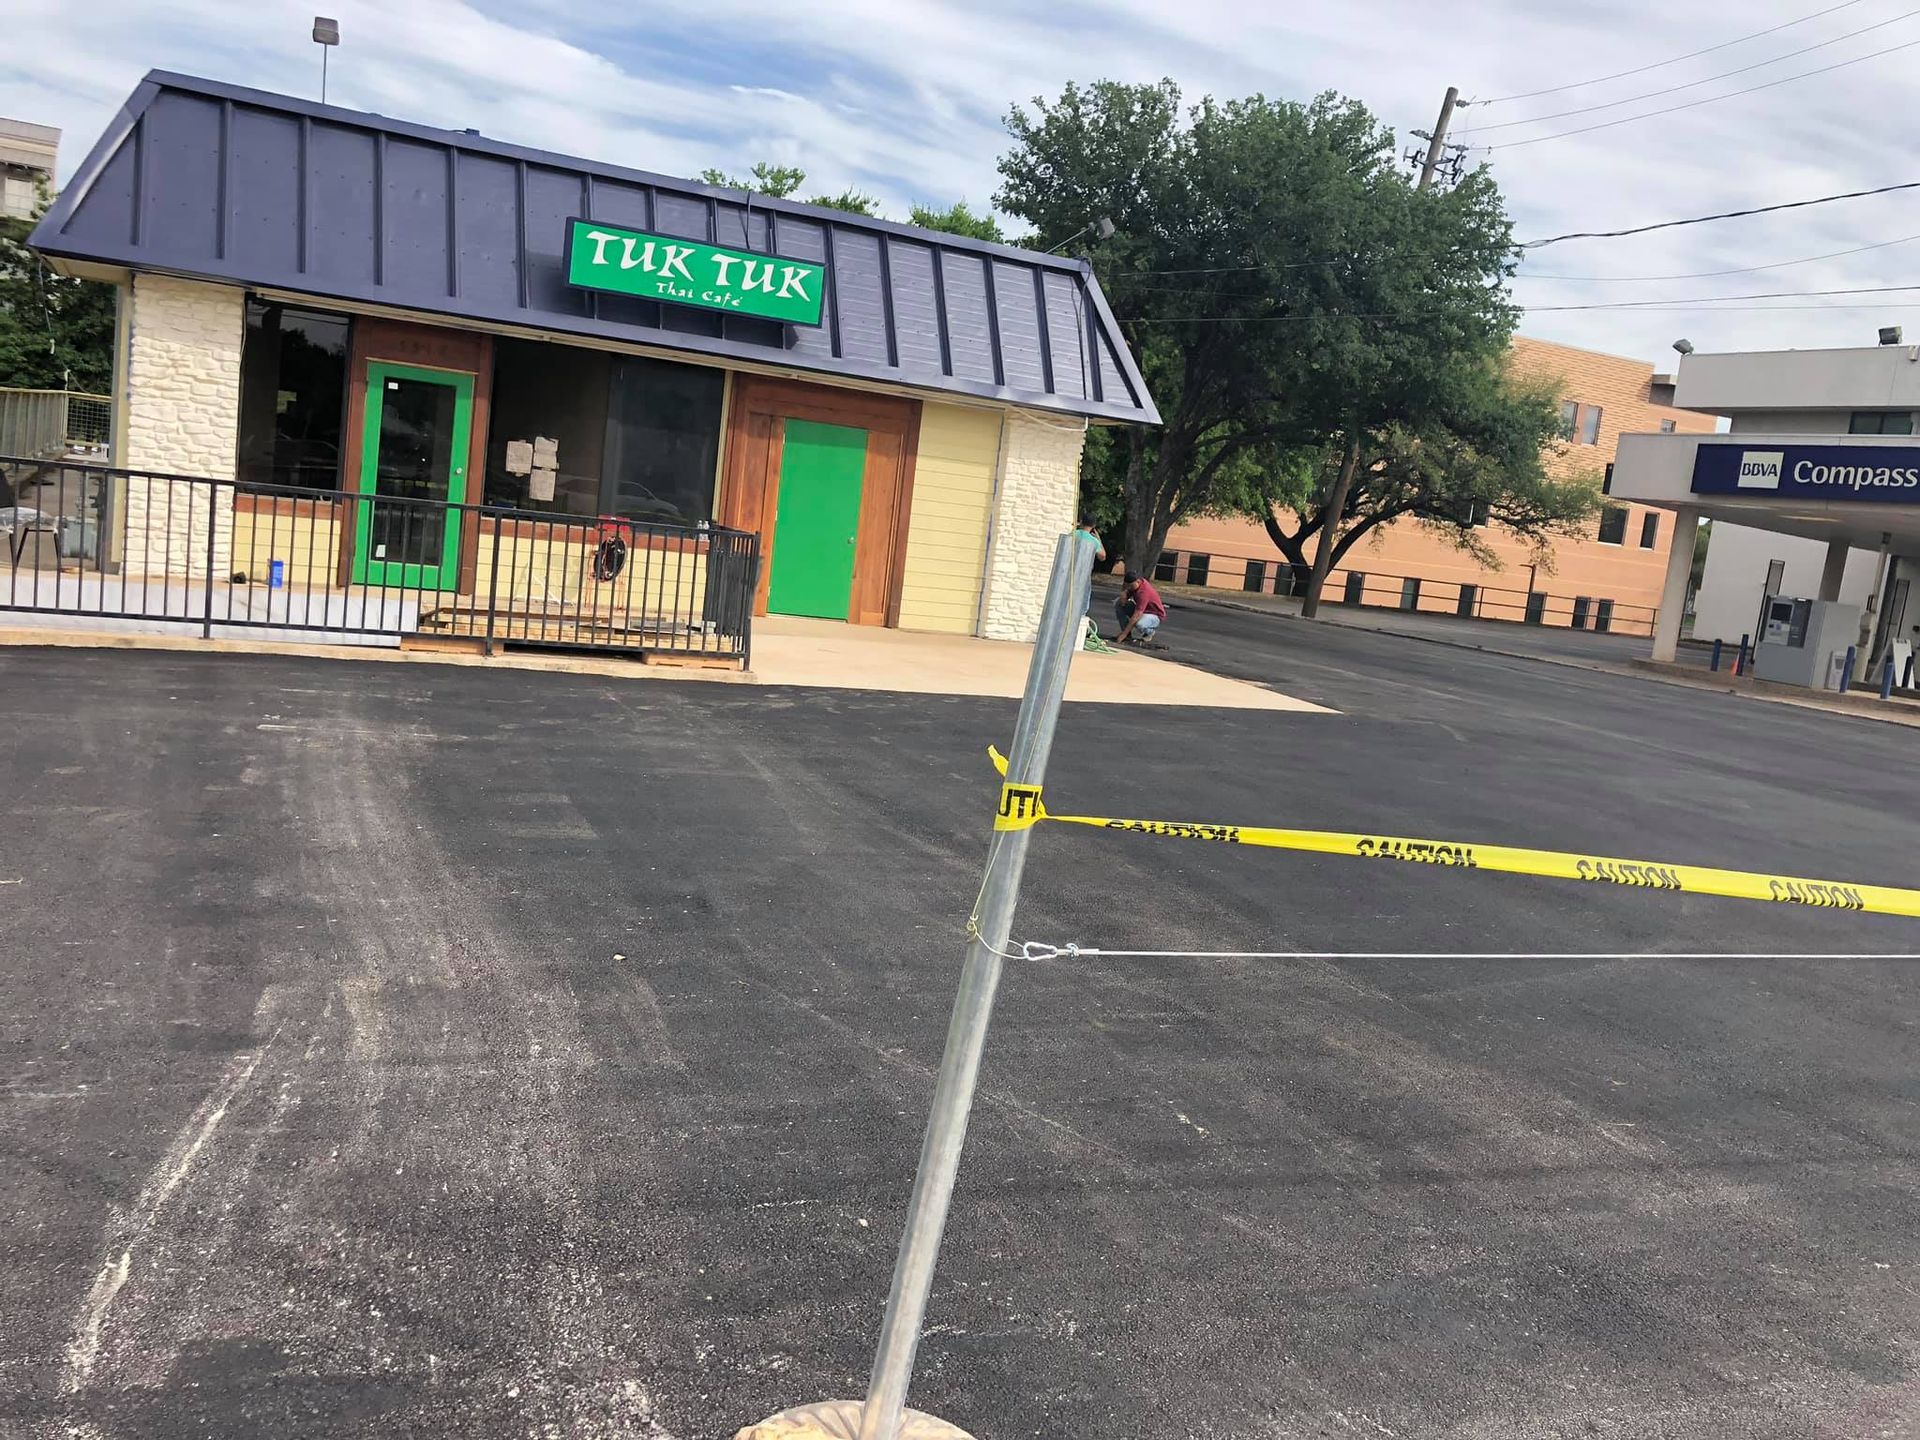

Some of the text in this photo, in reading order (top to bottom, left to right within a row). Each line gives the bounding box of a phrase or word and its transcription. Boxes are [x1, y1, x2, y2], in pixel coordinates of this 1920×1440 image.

[586, 231, 812, 302] TUK TUK
[656, 282, 693, 299] Thai
[1741, 460, 1919, 491] BBVA Compass
[1356, 839, 1477, 867] CAUTION
[1576, 859, 1681, 890] CAUTION
[1770, 880, 1864, 911] CAUTION
